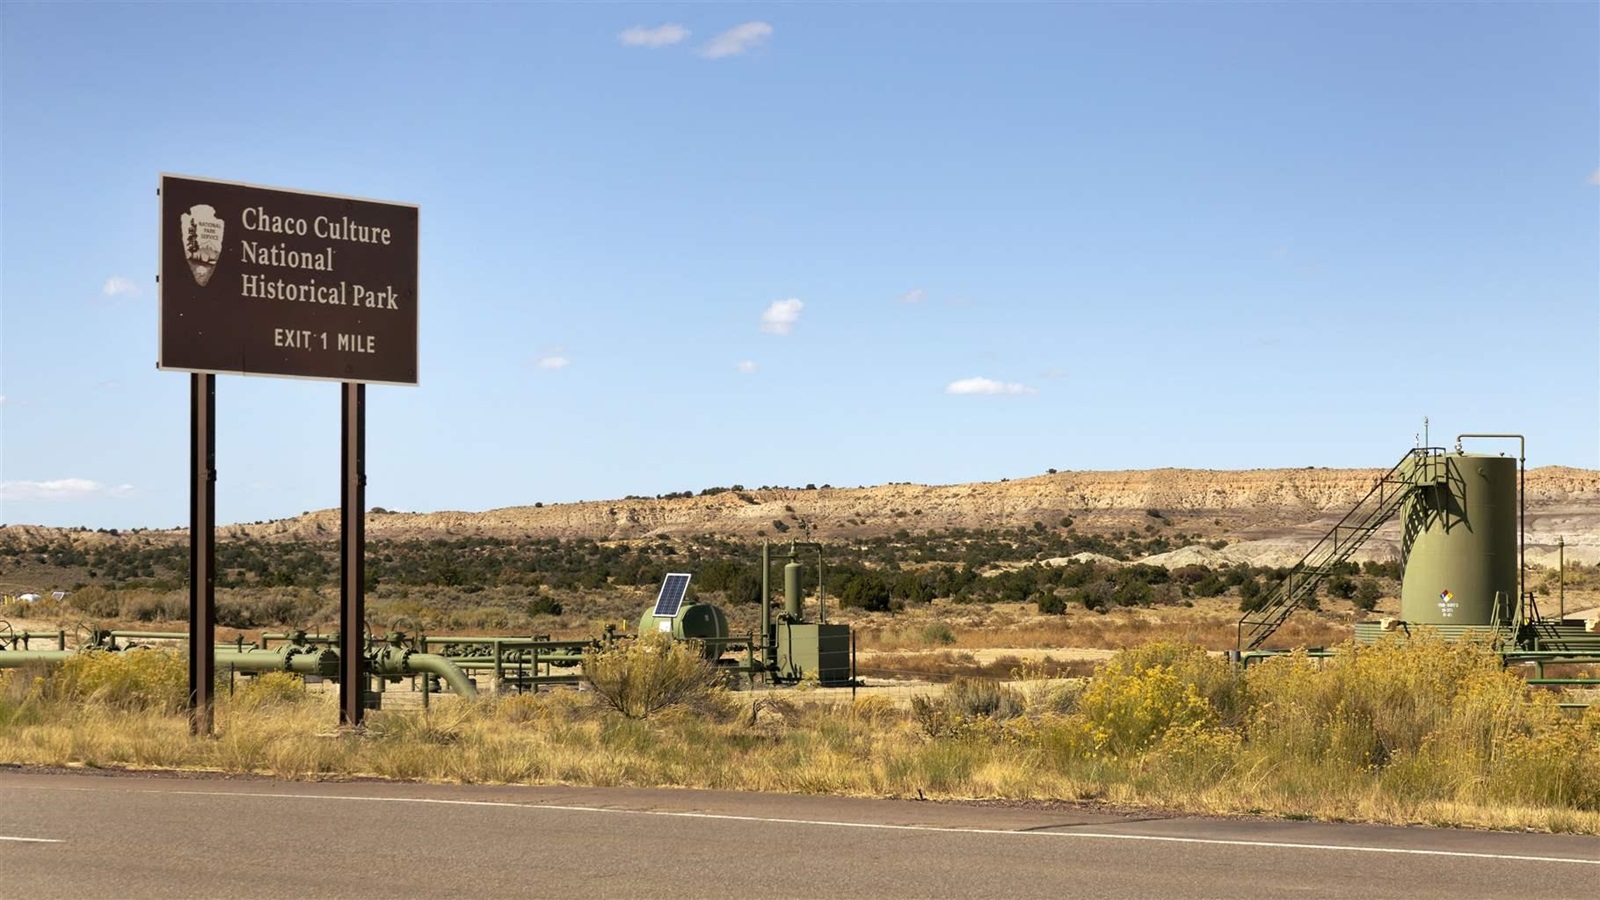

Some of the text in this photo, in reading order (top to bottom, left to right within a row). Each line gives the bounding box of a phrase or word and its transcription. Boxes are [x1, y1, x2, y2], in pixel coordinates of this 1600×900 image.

[199, 221, 221, 229] NATIONAL
[241, 206, 391, 245] Chaco Culture
[241, 240, 333, 271] National
[241, 274, 399, 310] Historical Park
[274, 328, 376, 353] EXIT 1 MILE
